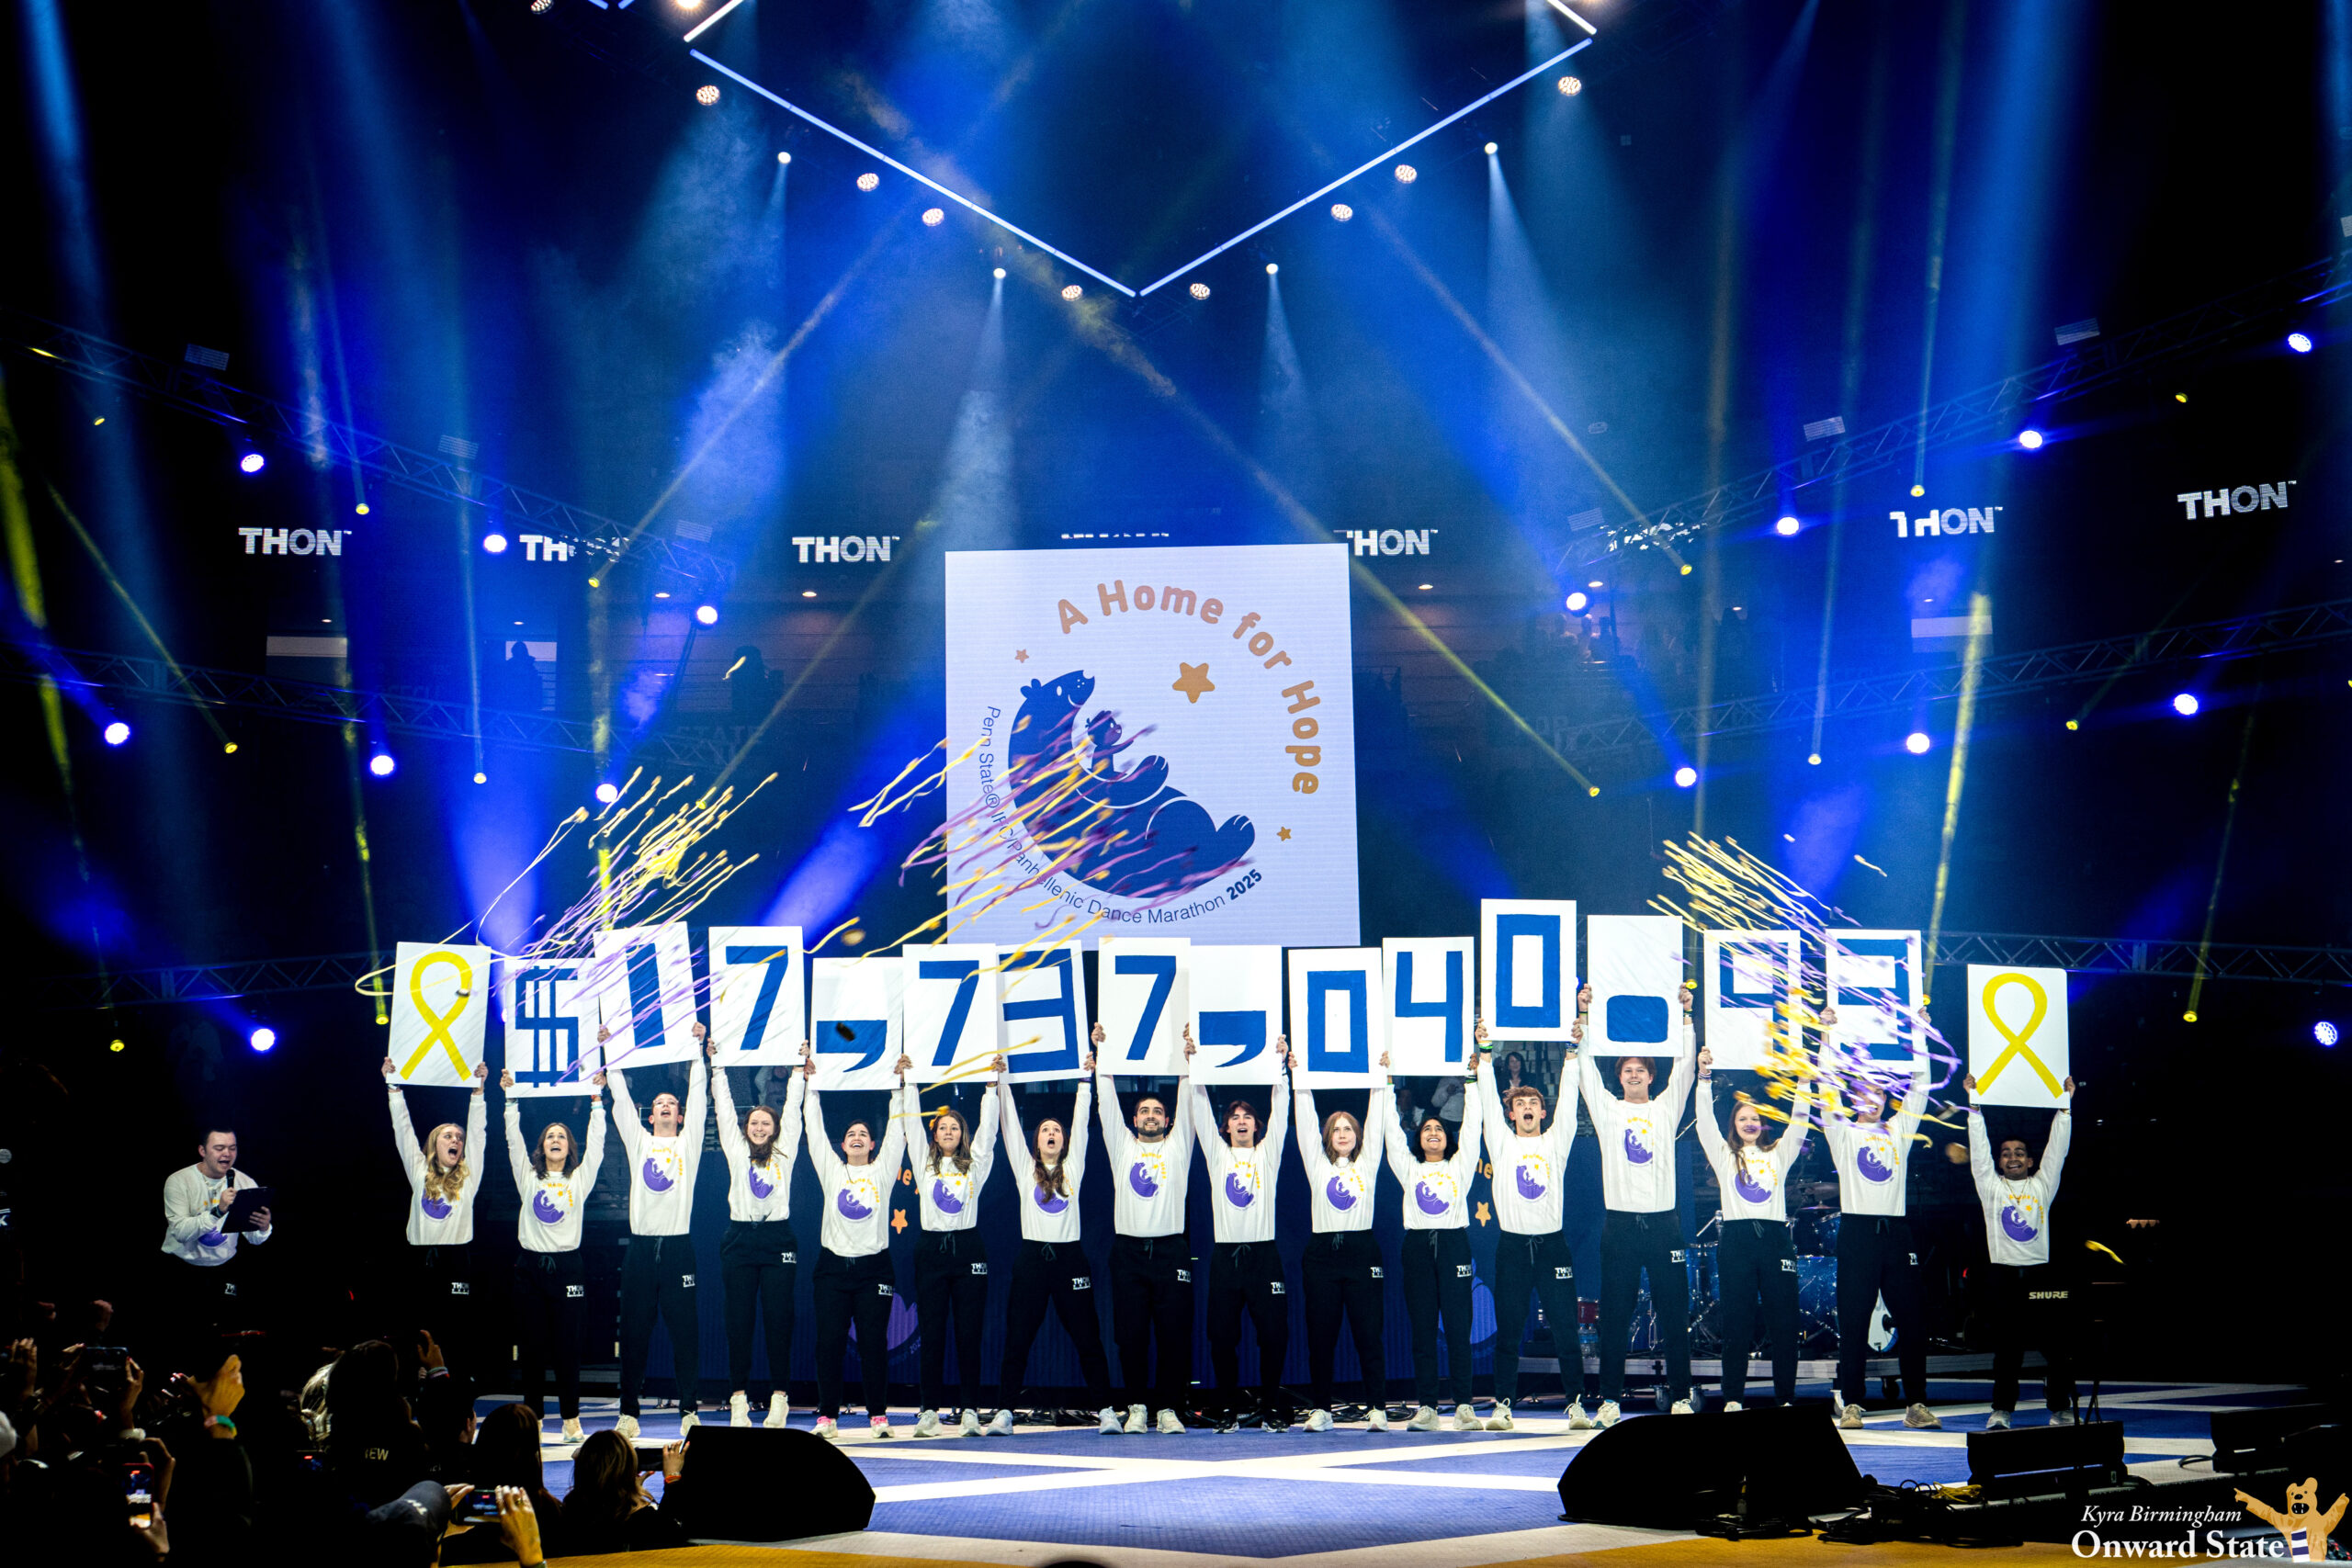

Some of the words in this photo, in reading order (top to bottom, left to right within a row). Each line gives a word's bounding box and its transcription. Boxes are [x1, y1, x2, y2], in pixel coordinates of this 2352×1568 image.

[2177, 481, 2289, 520] THON
[238, 527, 343, 555] THON
[792, 536, 891, 562] THON
[1057, 598, 1088, 634] A
[1097, 580, 1224, 624] Home
[1232, 612, 1292, 669] for
[1282, 680, 1321, 795] Hope
[979, 705, 1001, 747] Penn
[1087, 899, 1142, 923] Dance
[1148, 895, 1225, 923] Marathon
[1226, 869, 1262, 900] 2025
[2029, 1291, 2068, 1300] SHURE
